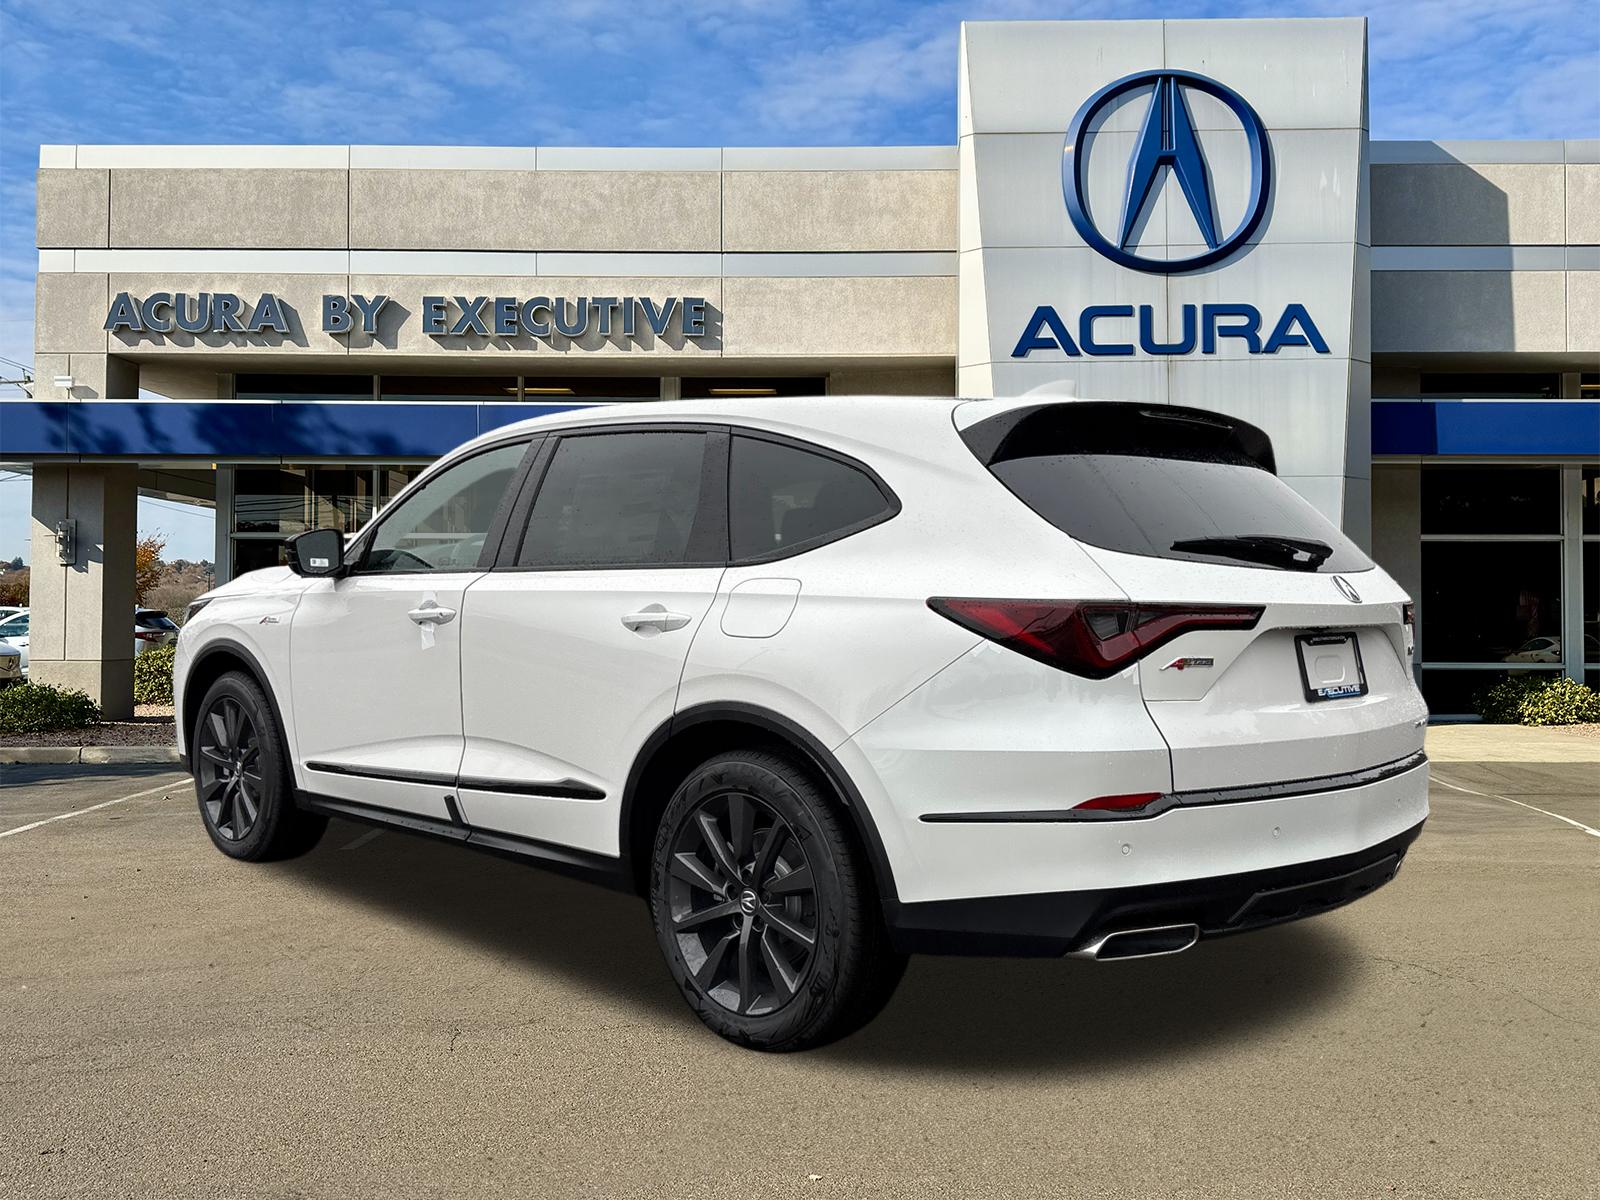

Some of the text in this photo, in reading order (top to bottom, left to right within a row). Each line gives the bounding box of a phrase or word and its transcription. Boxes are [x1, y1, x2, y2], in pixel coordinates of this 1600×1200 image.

[103, 292, 705, 337] ACURA BY EXECUTIVE
[1010, 303, 1331, 357] ACURA
